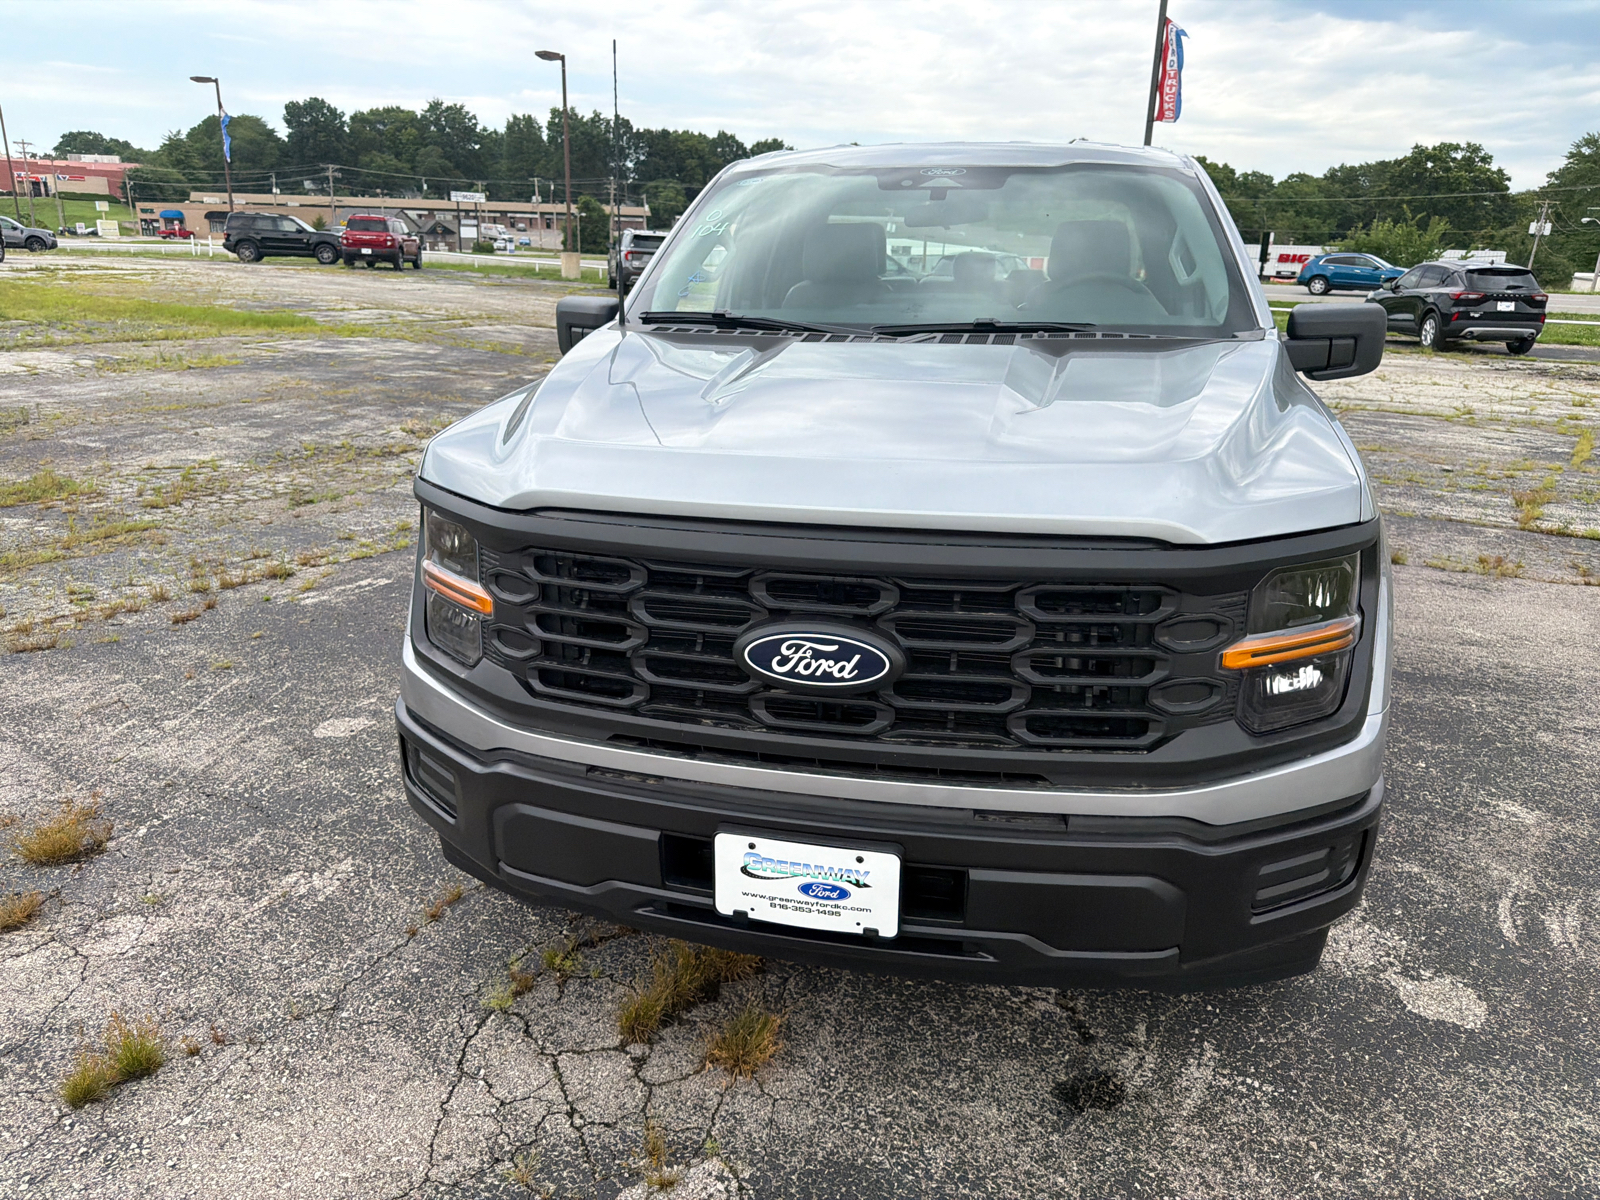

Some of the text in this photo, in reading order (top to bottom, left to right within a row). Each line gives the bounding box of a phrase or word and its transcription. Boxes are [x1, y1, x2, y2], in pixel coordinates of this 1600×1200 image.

[1163, 70, 1178, 119] TRUCKS
[1277, 253, 1311, 264] BIG
[771, 639, 862, 679] Ford
[742, 851, 871, 885] GREENWAY
[741, 890, 872, 914] www.greenwayfordkc.com
[808, 882, 840, 899] Ford
[769, 902, 842, 917] 816-353-1495
